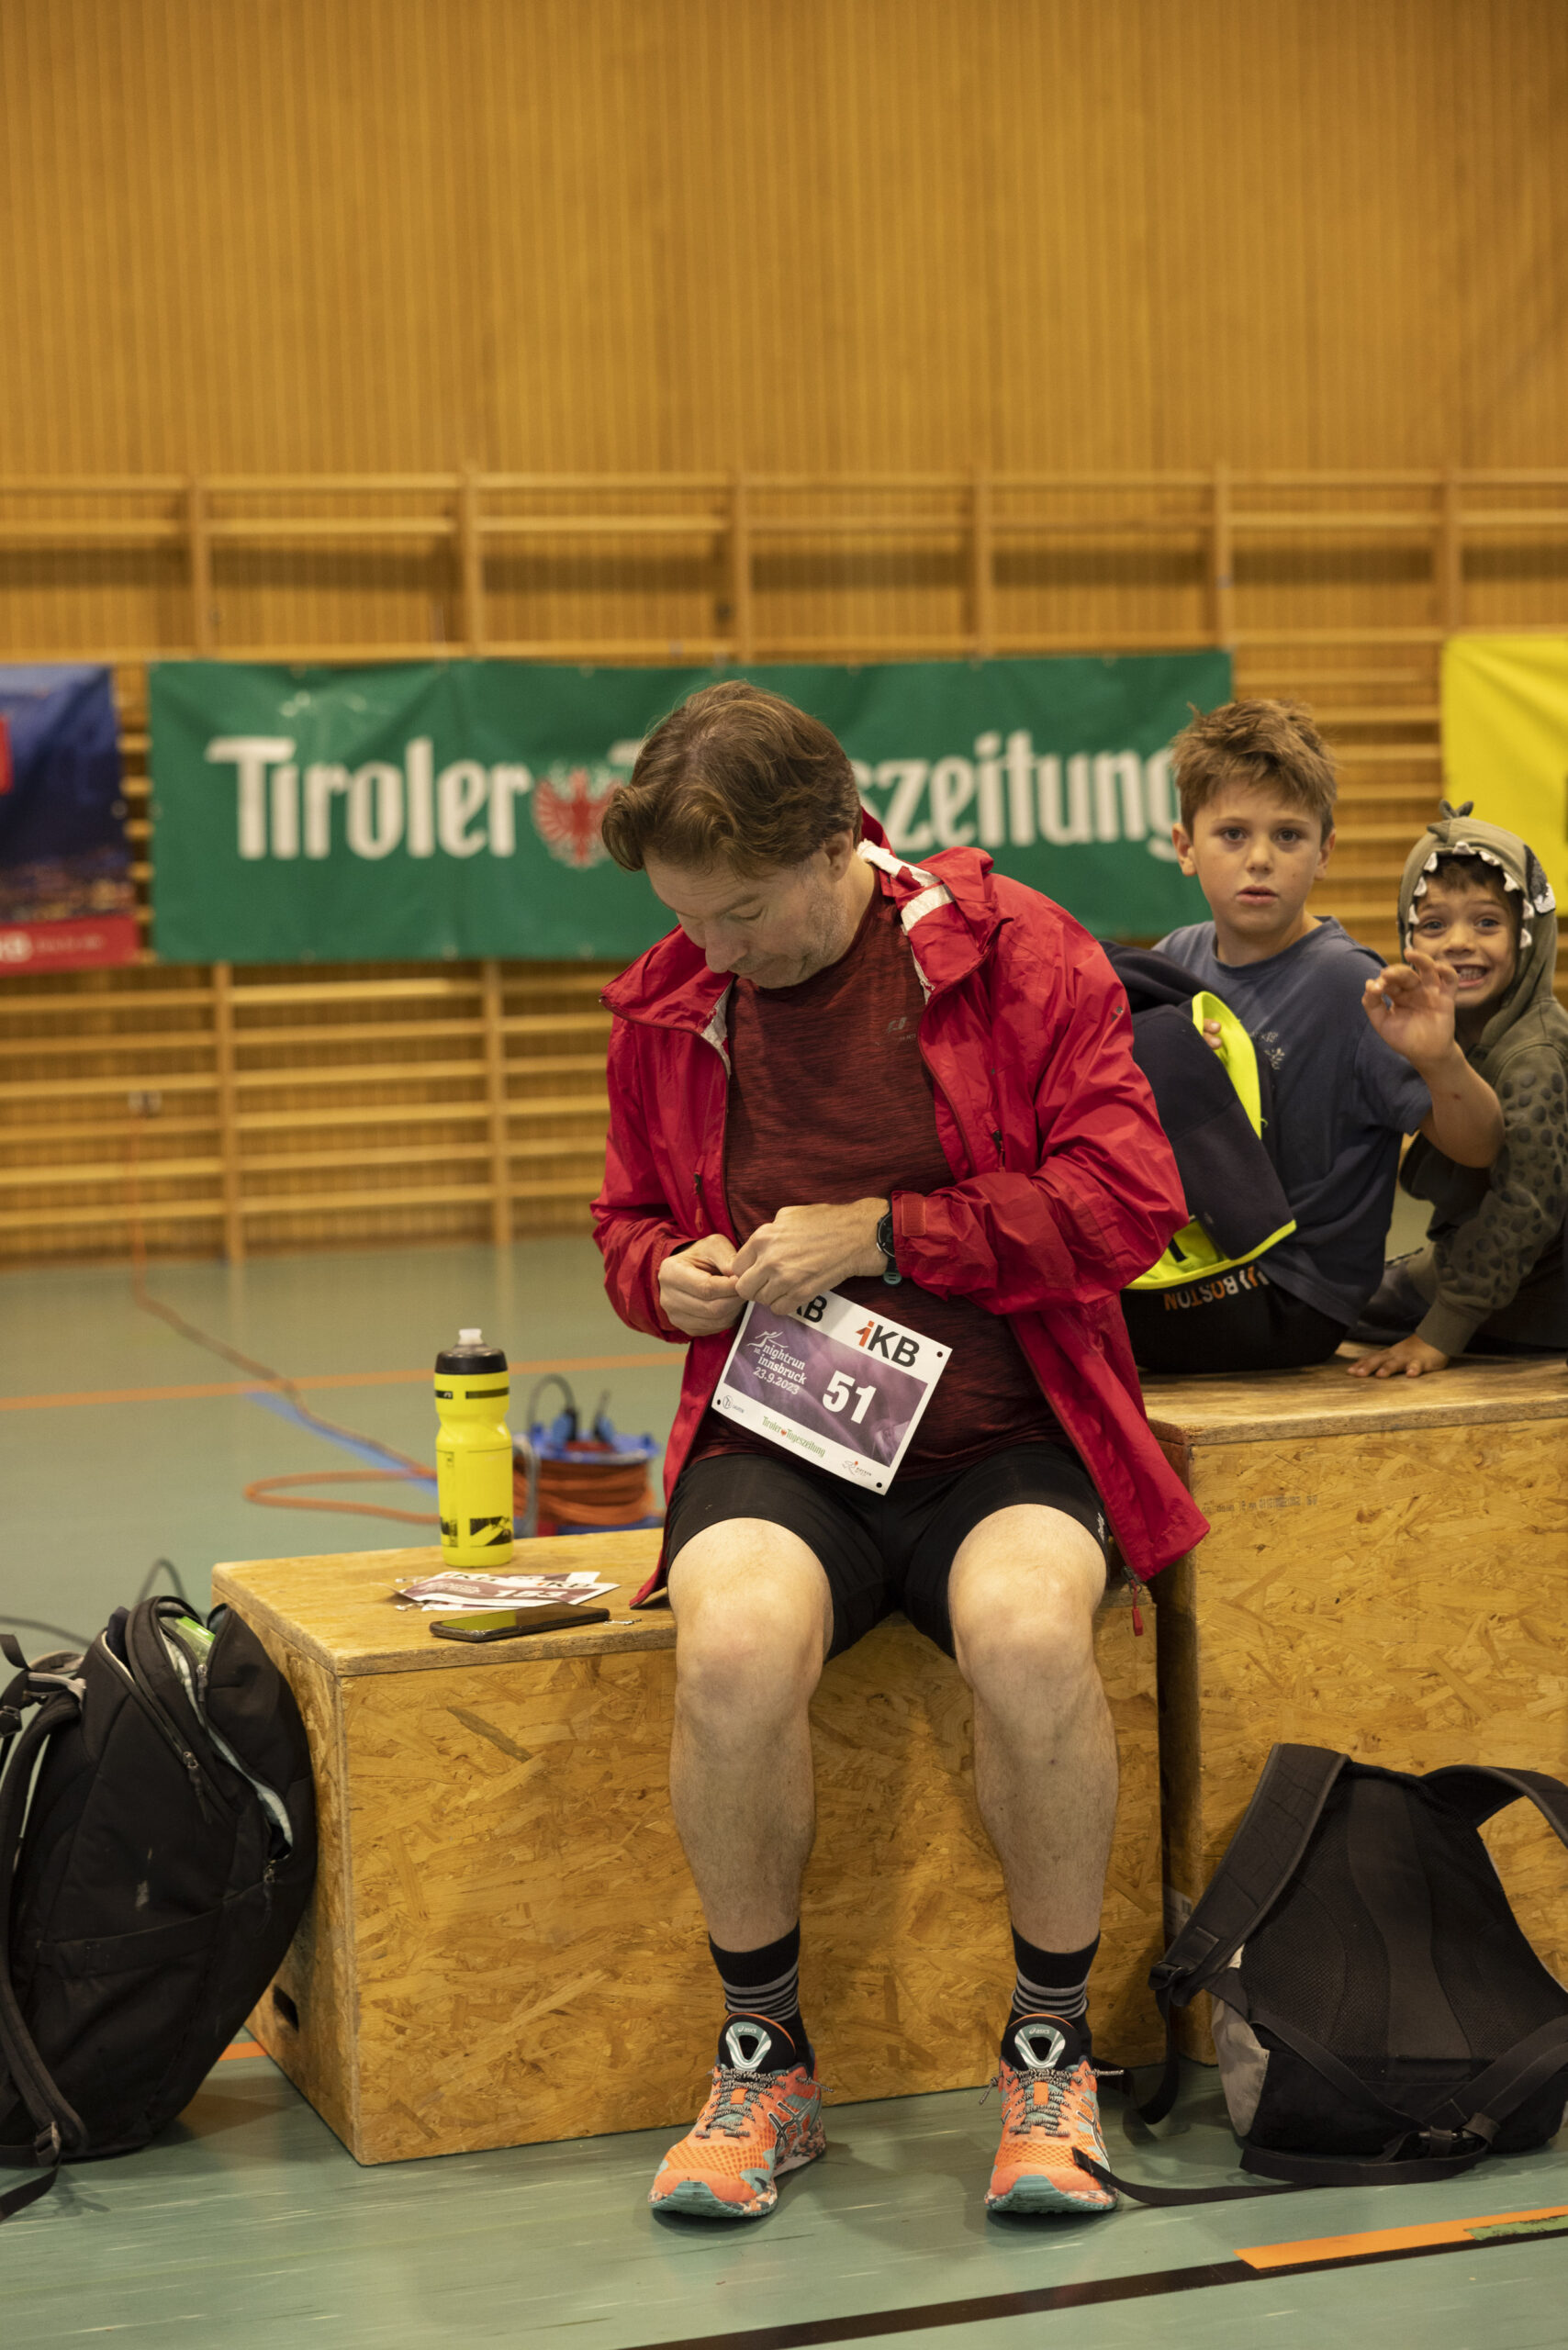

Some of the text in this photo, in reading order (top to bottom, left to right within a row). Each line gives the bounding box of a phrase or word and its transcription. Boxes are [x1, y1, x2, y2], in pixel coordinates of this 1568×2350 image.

[206, 736, 532, 859] Tiroler
[1163, 1275, 1239, 1311] BOSTON
[757, 1353, 807, 1384] innsbruck
[762, 1345, 806, 1370] nightrun
[753, 1367, 801, 1394] 23.9.2023
[823, 1371, 877, 1425] 51
[762, 1416, 826, 1458] Tiroler Tageszeitung
[494, 1589, 567, 1598] 153
